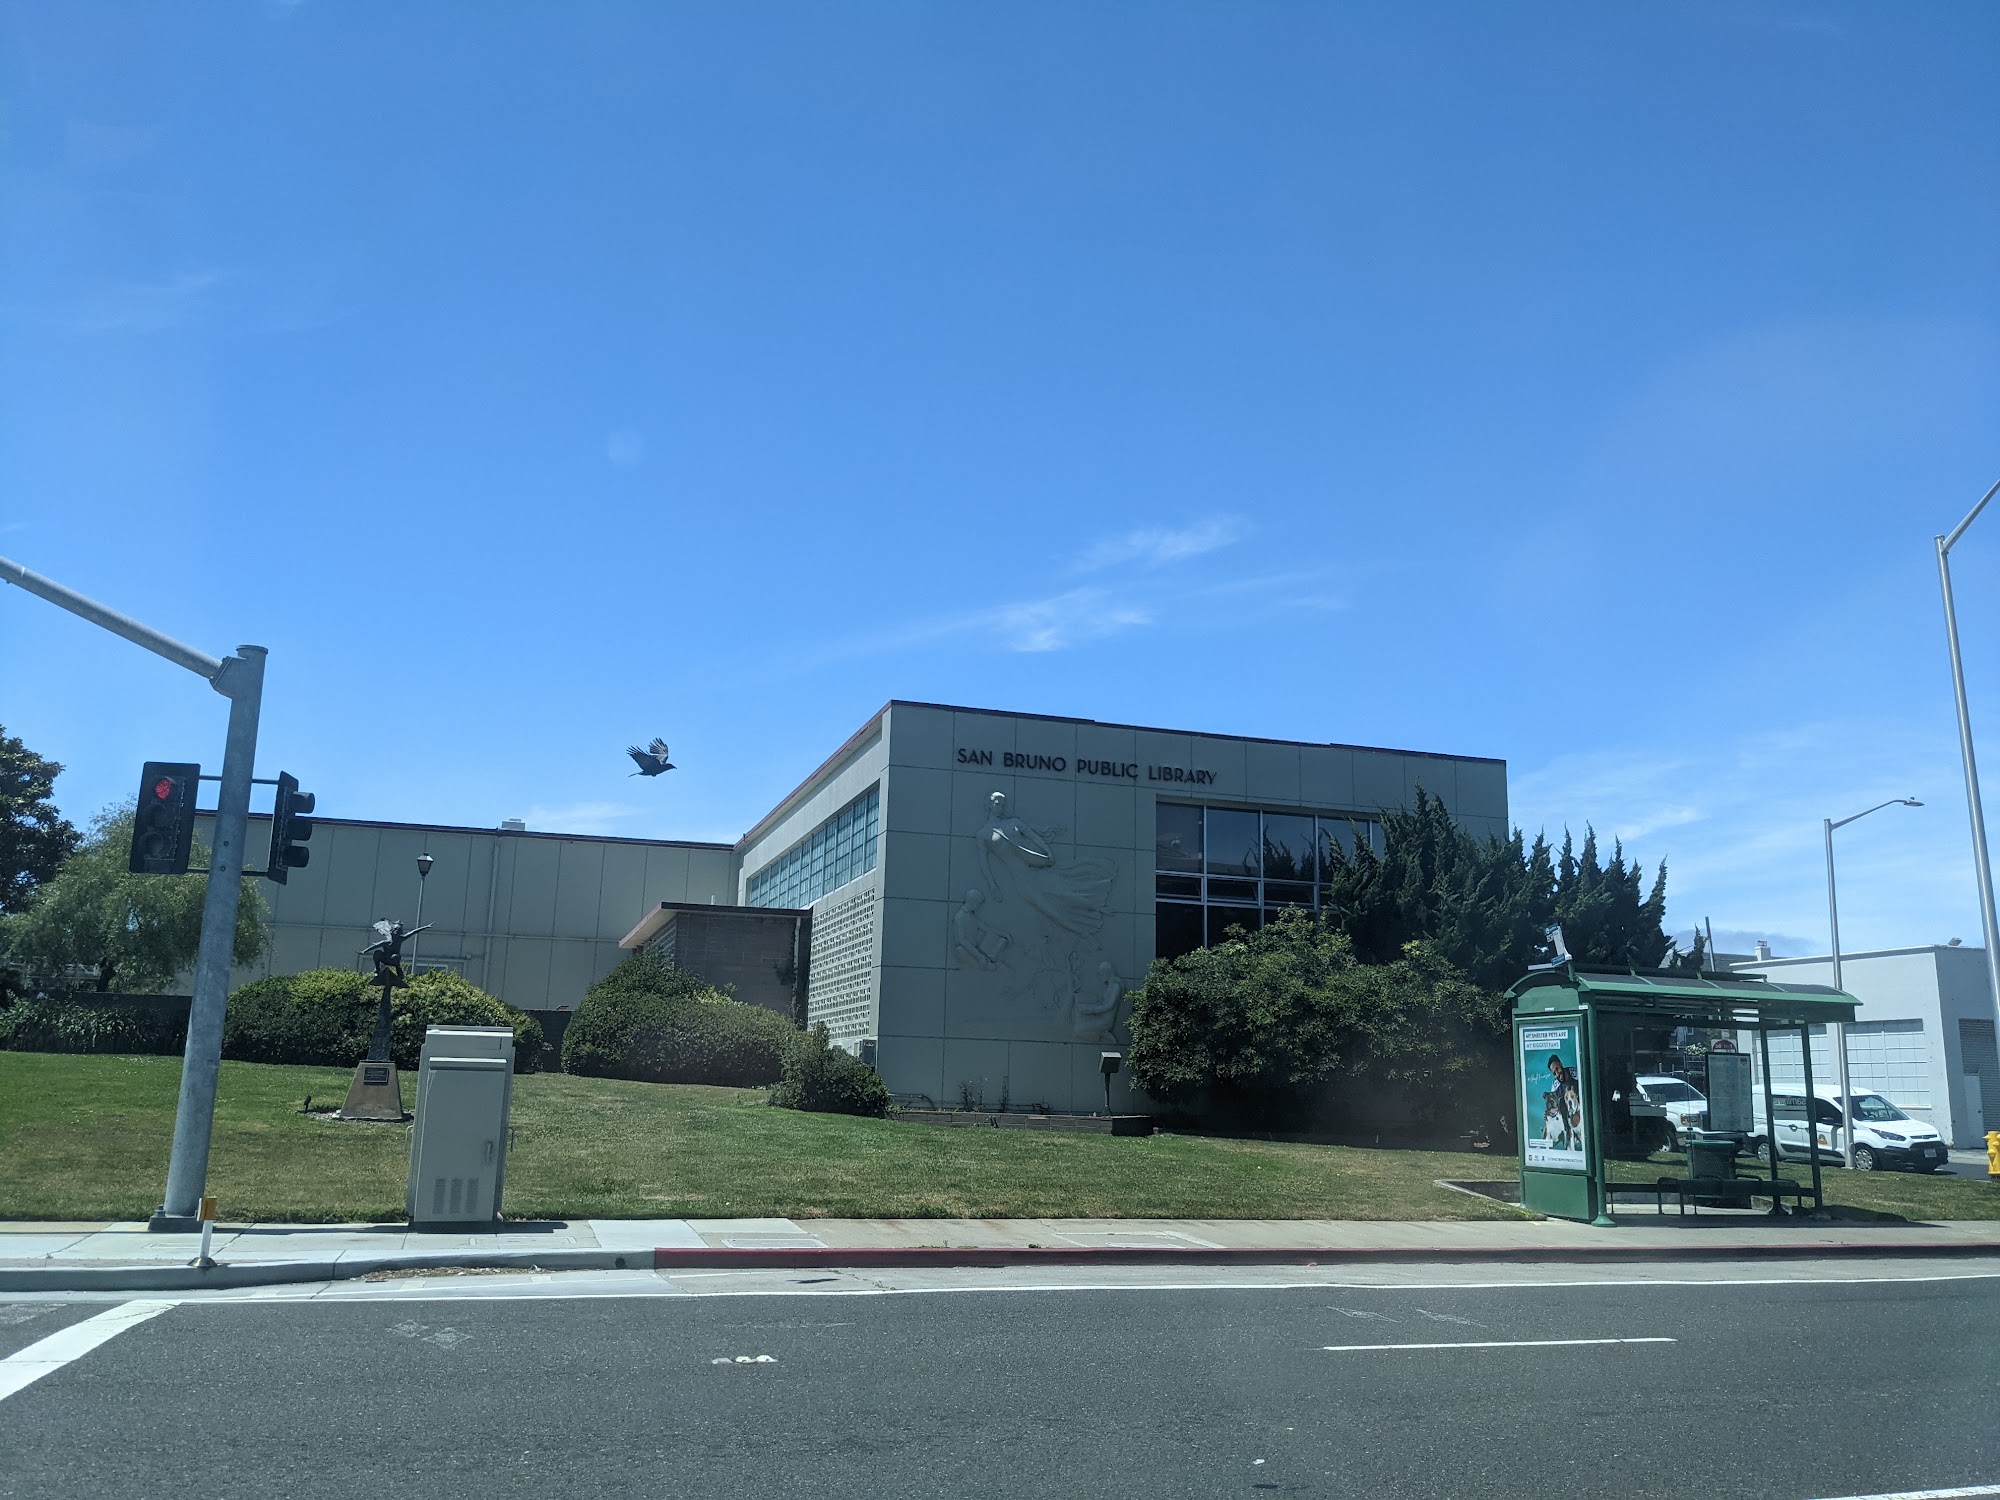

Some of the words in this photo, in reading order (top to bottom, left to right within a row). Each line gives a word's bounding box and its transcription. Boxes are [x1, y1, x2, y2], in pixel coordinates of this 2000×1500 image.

[957, 748, 993, 766] SAN
[1003, 752, 1067, 772] BRUNO
[1077, 758, 1138, 779] PUBLIC
[1148, 765, 1218, 785] LIBRARY
